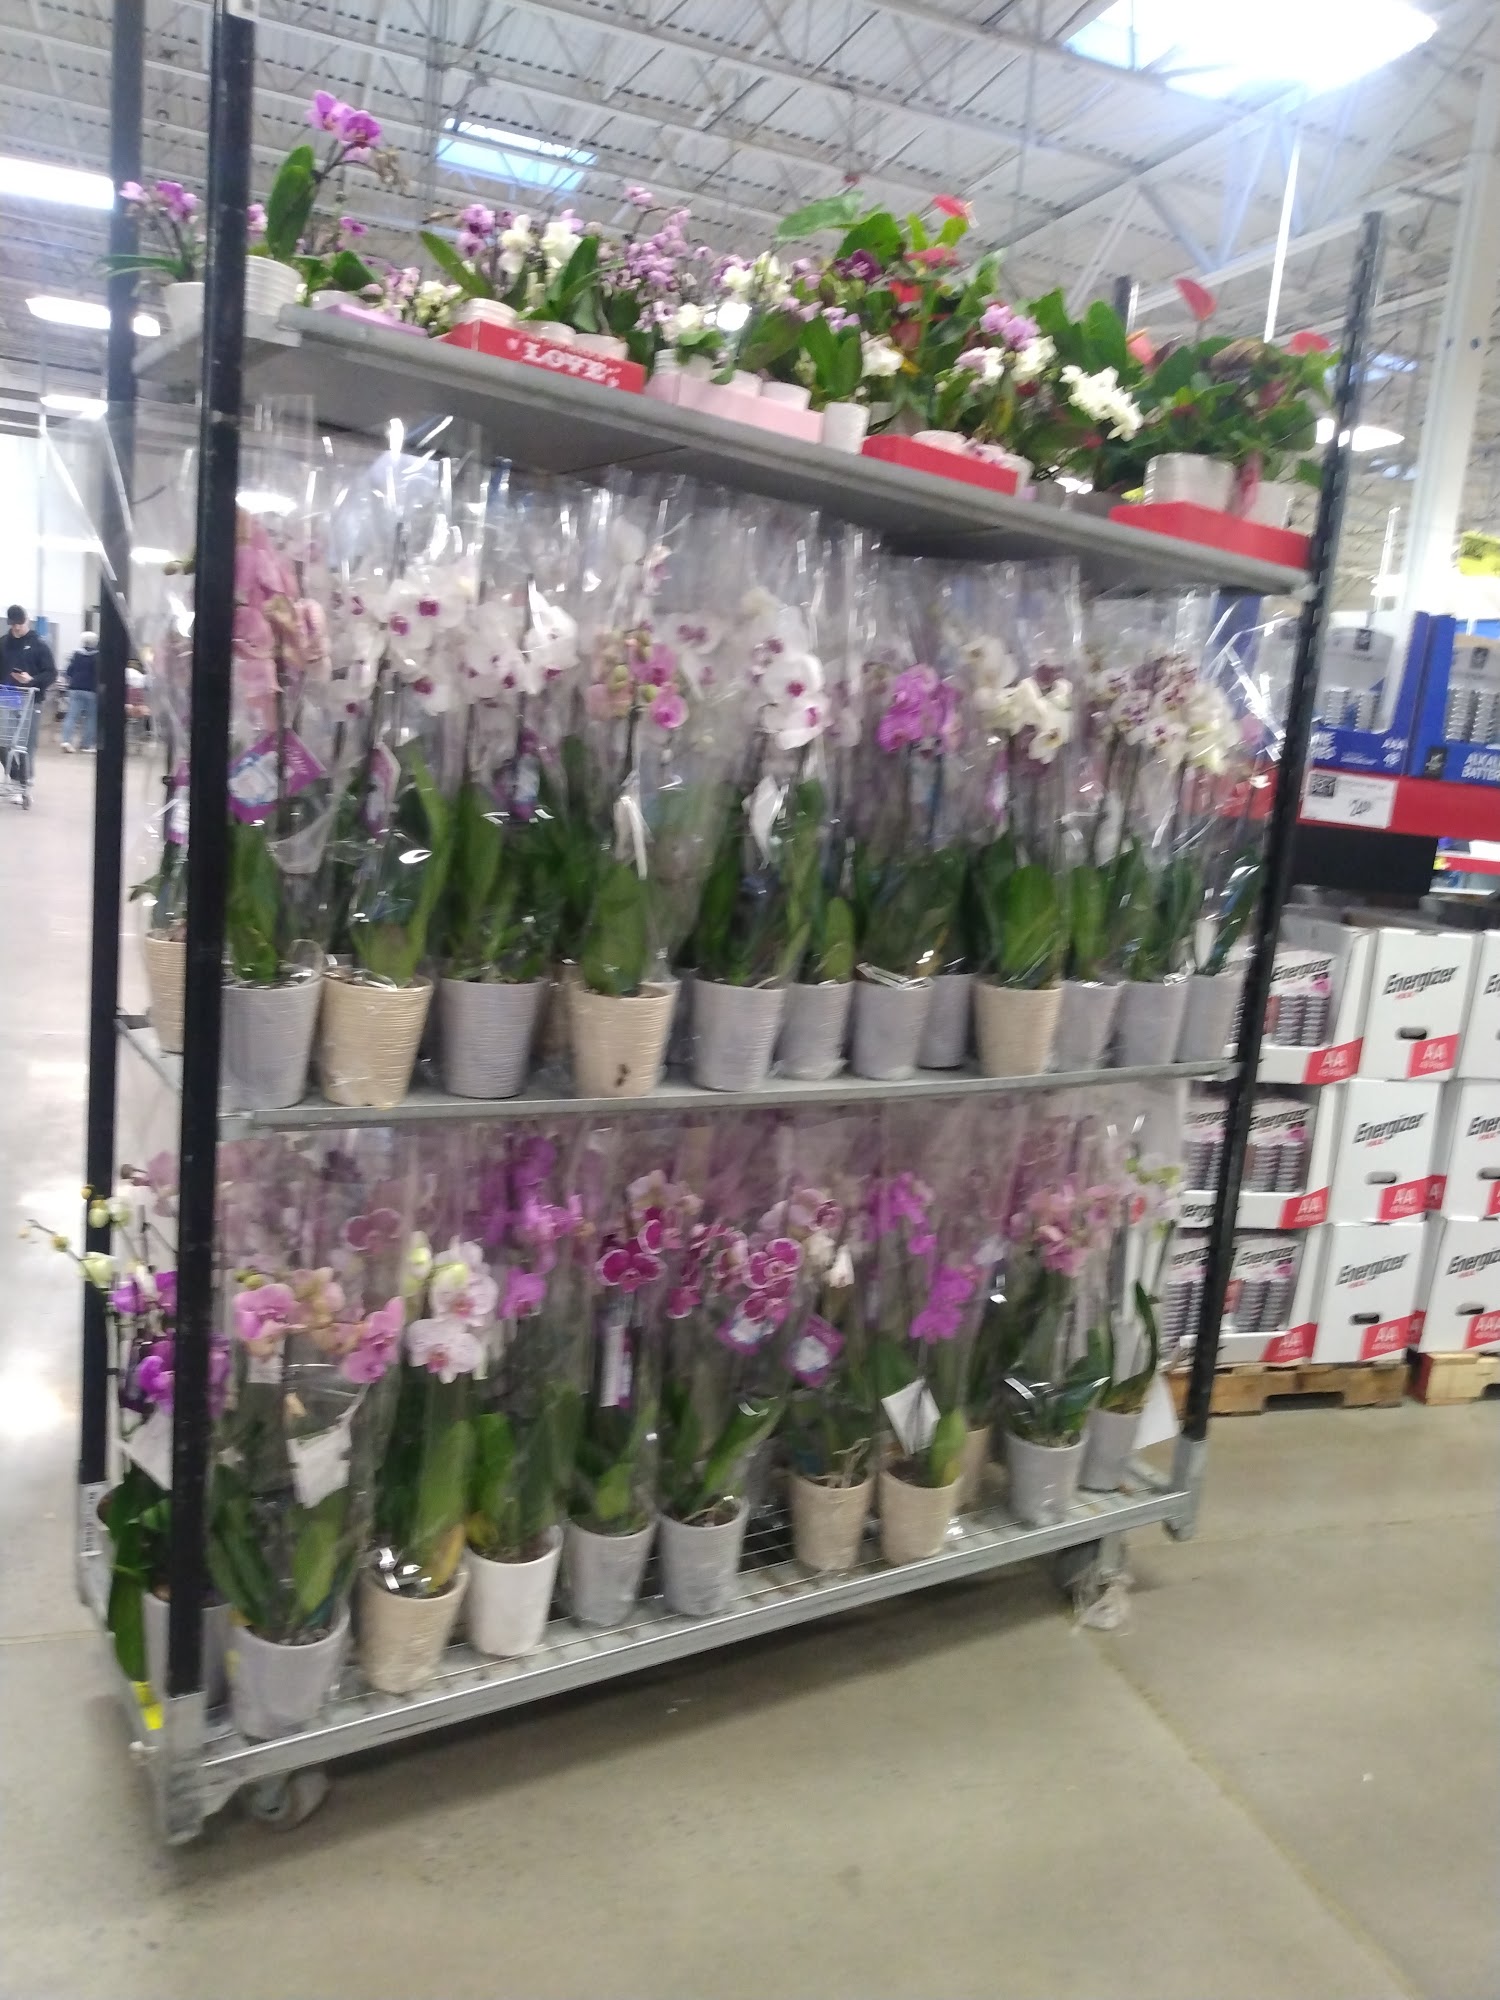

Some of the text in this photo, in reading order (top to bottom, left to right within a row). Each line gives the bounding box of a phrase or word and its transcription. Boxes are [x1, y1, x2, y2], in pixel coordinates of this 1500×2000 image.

[523, 341, 608, 381] LOVE
[1271, 957, 1334, 983] Energizer
[1382, 965, 1459, 995] Energizer
[1421, 1043, 1448, 1061] AA
[1352, 1112, 1428, 1144] Energizer
[1392, 1188, 1418, 1205] AA
[1335, 1253, 1409, 1286] Energizer
[1374, 1326, 1399, 1343] AA
